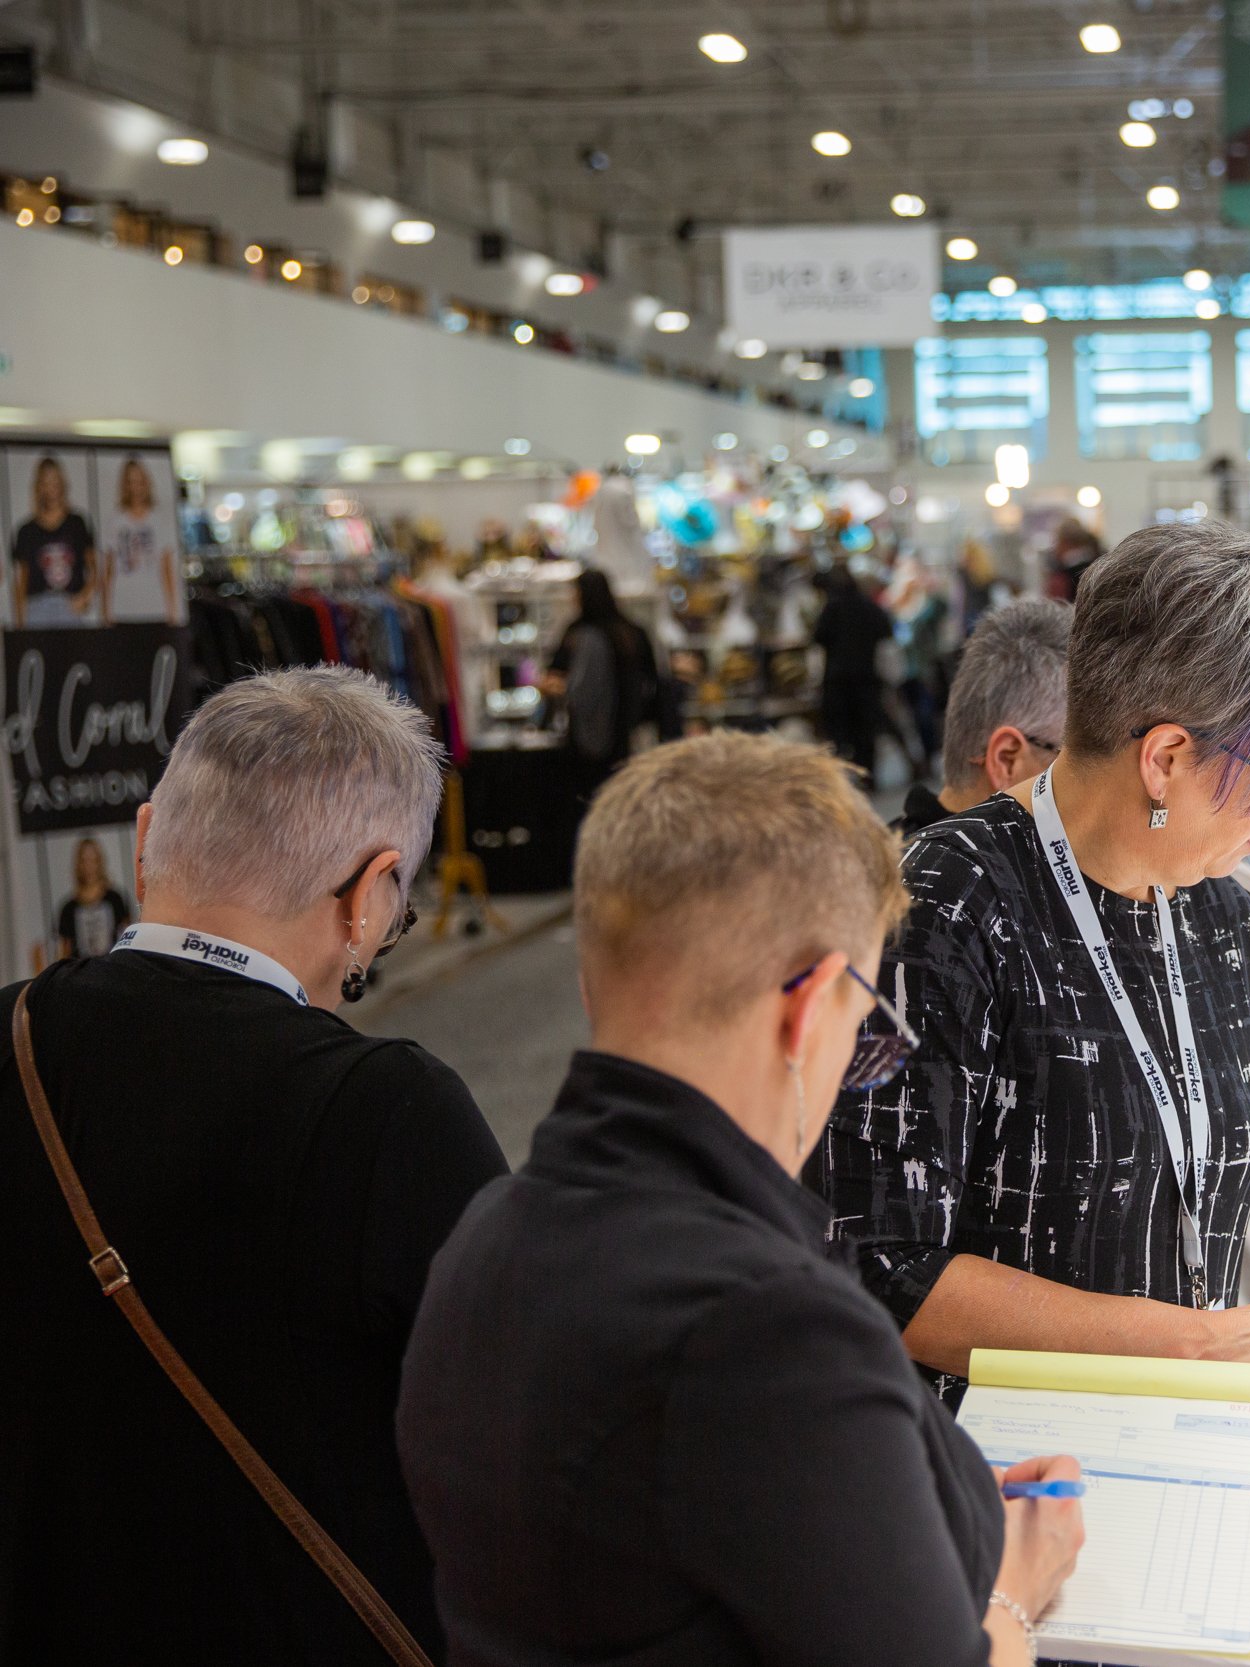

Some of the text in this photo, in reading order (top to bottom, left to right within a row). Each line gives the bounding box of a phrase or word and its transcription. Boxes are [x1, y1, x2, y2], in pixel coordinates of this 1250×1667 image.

[58, 644, 177, 768] Coral
[1050, 840, 1080, 895] market
[1056, 868, 1071, 897] TORONTO
[182, 938, 249, 965] market
[211, 955, 247, 972] TORONTO
[1094, 945, 1123, 1000] market
[1166, 943, 1182, 997] market
[1140, 1050, 1169, 1106] market
[1184, 1047, 1201, 1103] market
